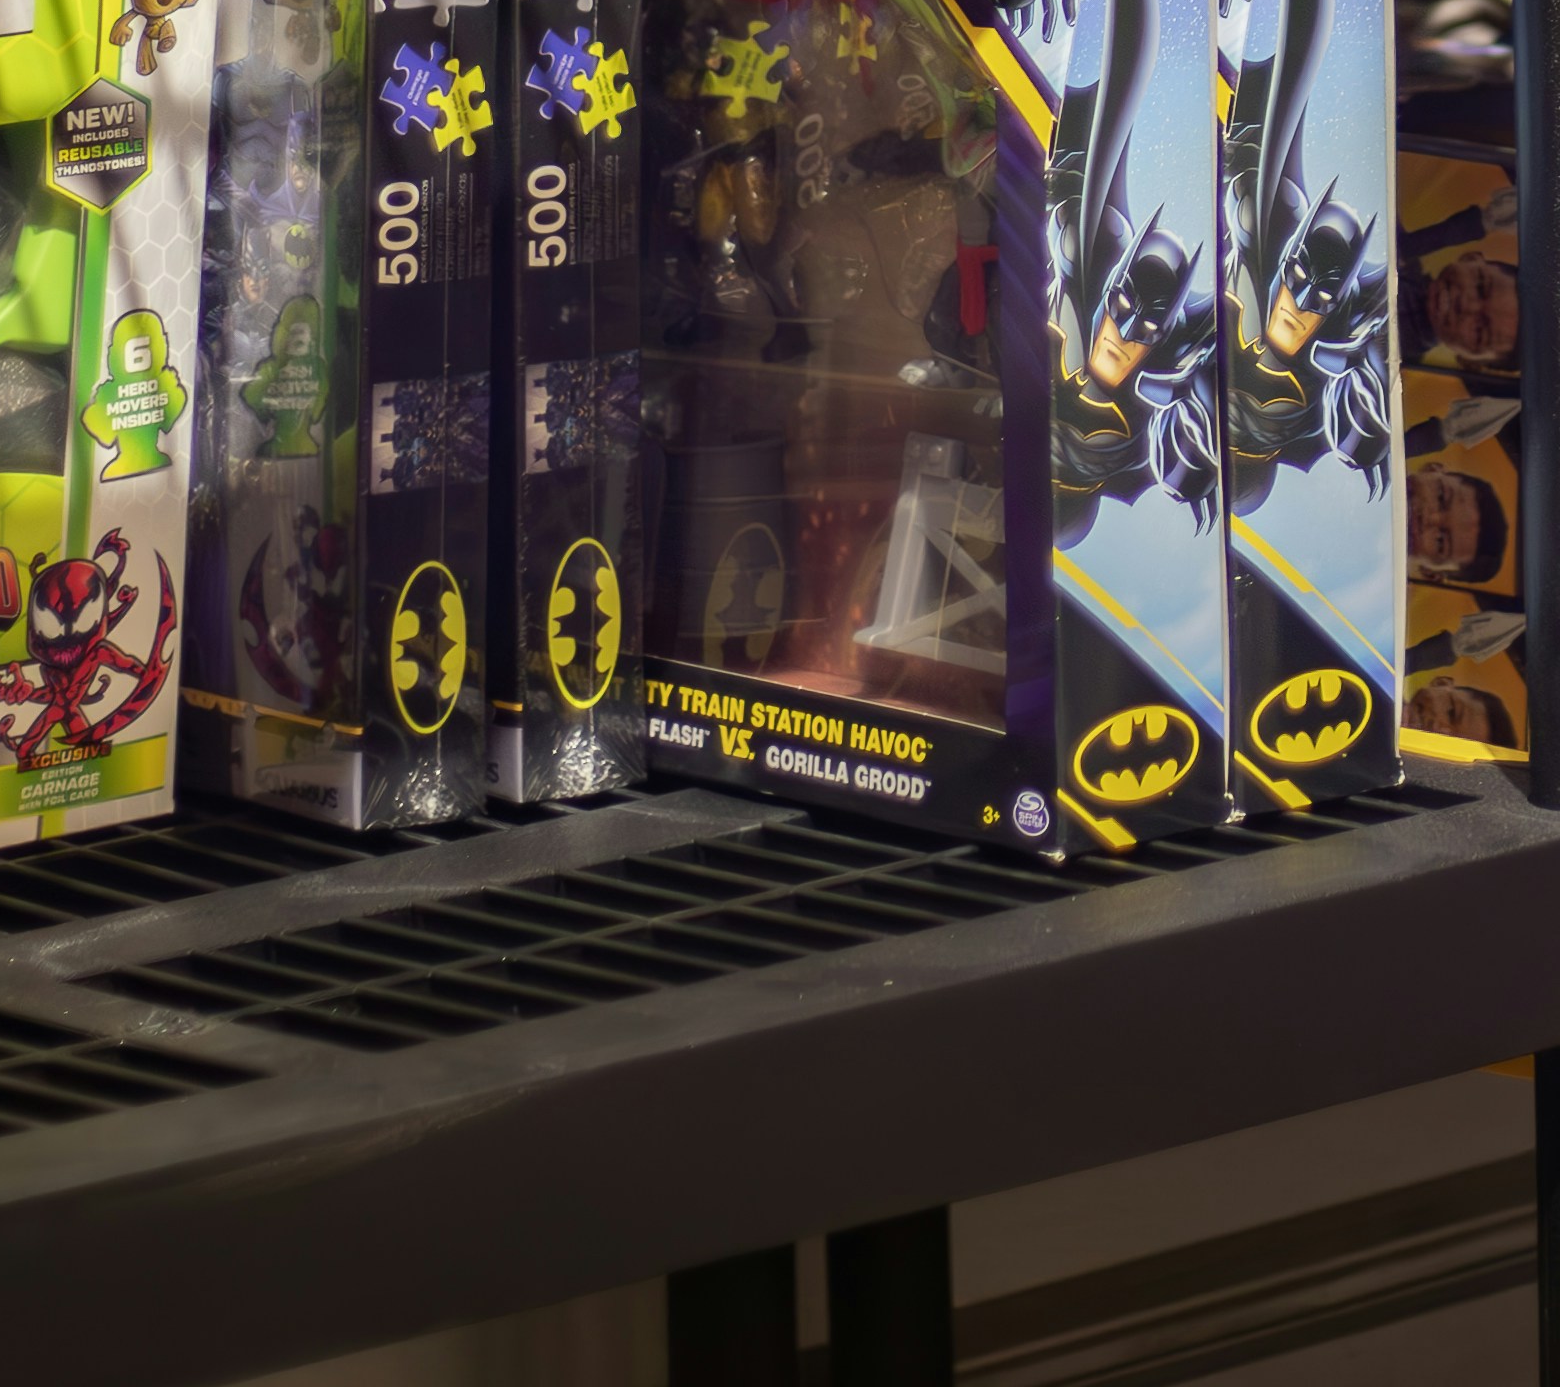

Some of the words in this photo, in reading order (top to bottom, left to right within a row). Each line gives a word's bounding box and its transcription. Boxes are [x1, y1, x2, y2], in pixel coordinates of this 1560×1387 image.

[66, 101, 136, 132] NEW!
[72, 127, 130, 144] INCLUDES
[57, 138, 144, 164] REUSABLE
[54, 154, 146, 178] THANOSTONES!
[527, 164, 568, 268] 500
[378, 181, 420, 285] 500
[124, 335, 152, 373] 6
[117, 378, 158, 398] HERO
[106, 393, 169, 416] MOVERS
[111, 408, 165, 431] INSIDE!
[678, 685, 745, 724] TRAIN
[750, 702, 845, 746] STATION
[849, 722, 927, 764] HAVOC
[17, 739, 113, 775] EXCLUSIVE
[648, 717, 705, 749] FLASH
[718, 724, 757, 761] VS.
[764, 745, 850, 785] GORILLA
[853, 764, 926, 801] GRODD
[20, 771, 101, 800] CARNAGE
[981, 804, 1001, 825] 3+
